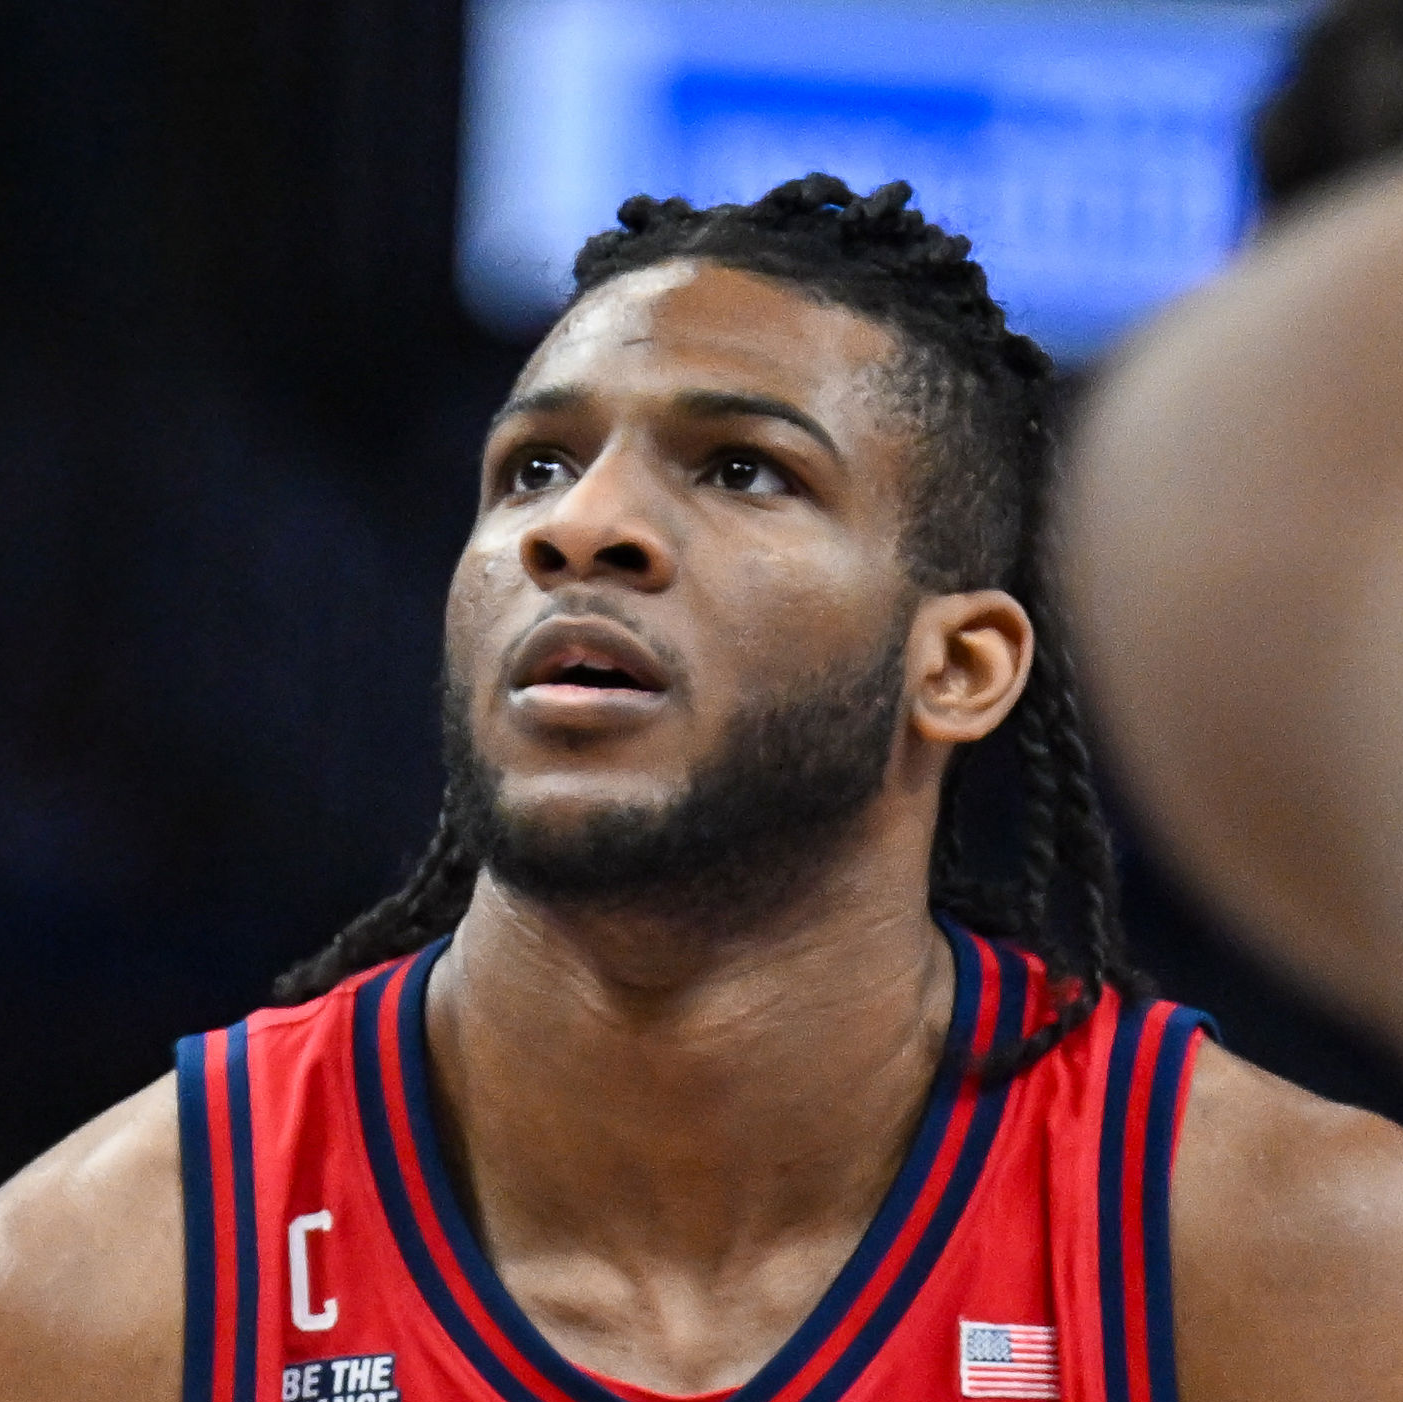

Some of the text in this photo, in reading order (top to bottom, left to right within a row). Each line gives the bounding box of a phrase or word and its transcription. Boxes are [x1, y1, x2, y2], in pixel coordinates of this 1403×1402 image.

[287, 1209, 339, 1333] C
[282, 1356, 394, 1402] BE THE
